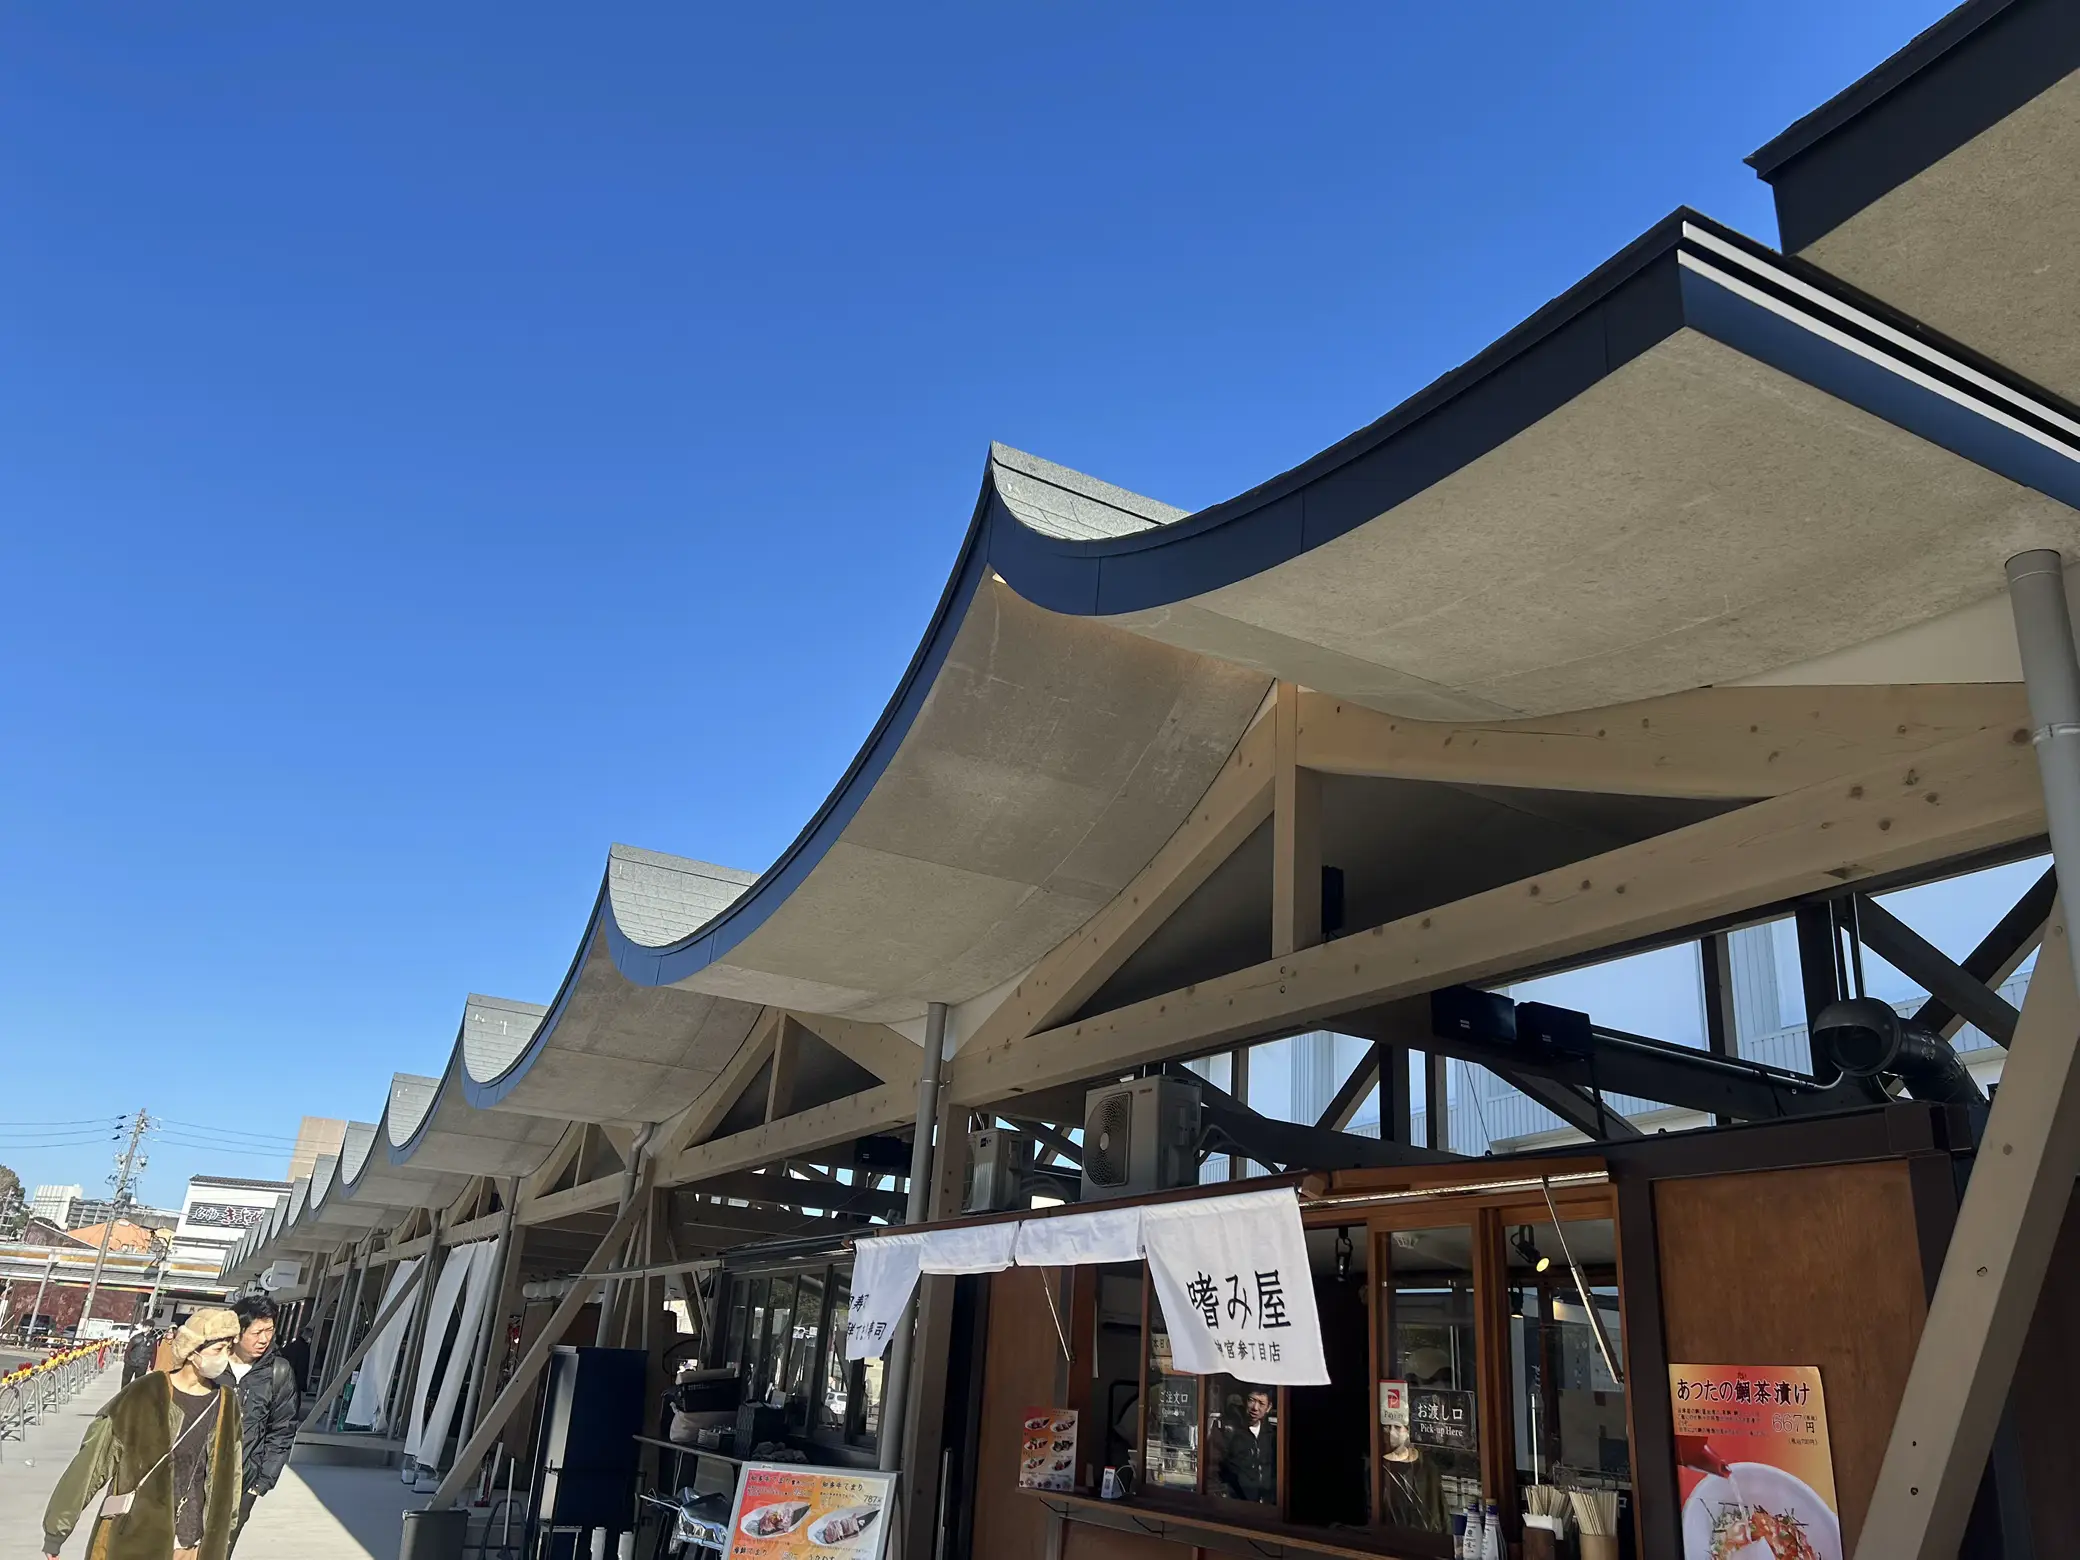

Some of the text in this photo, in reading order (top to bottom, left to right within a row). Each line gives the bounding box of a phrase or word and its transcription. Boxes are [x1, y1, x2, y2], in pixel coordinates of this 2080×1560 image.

[1185, 1269, 1292, 1330] 嗜み屋
[1160, 1389, 1189, 1405] ご注文口
[1677, 1378, 1812, 1406] あつたの鯛茶漬け
[1417, 1403, 1464, 1421] お渡し口
[1420, 1423, 1464, 1438] Pick-up Here
